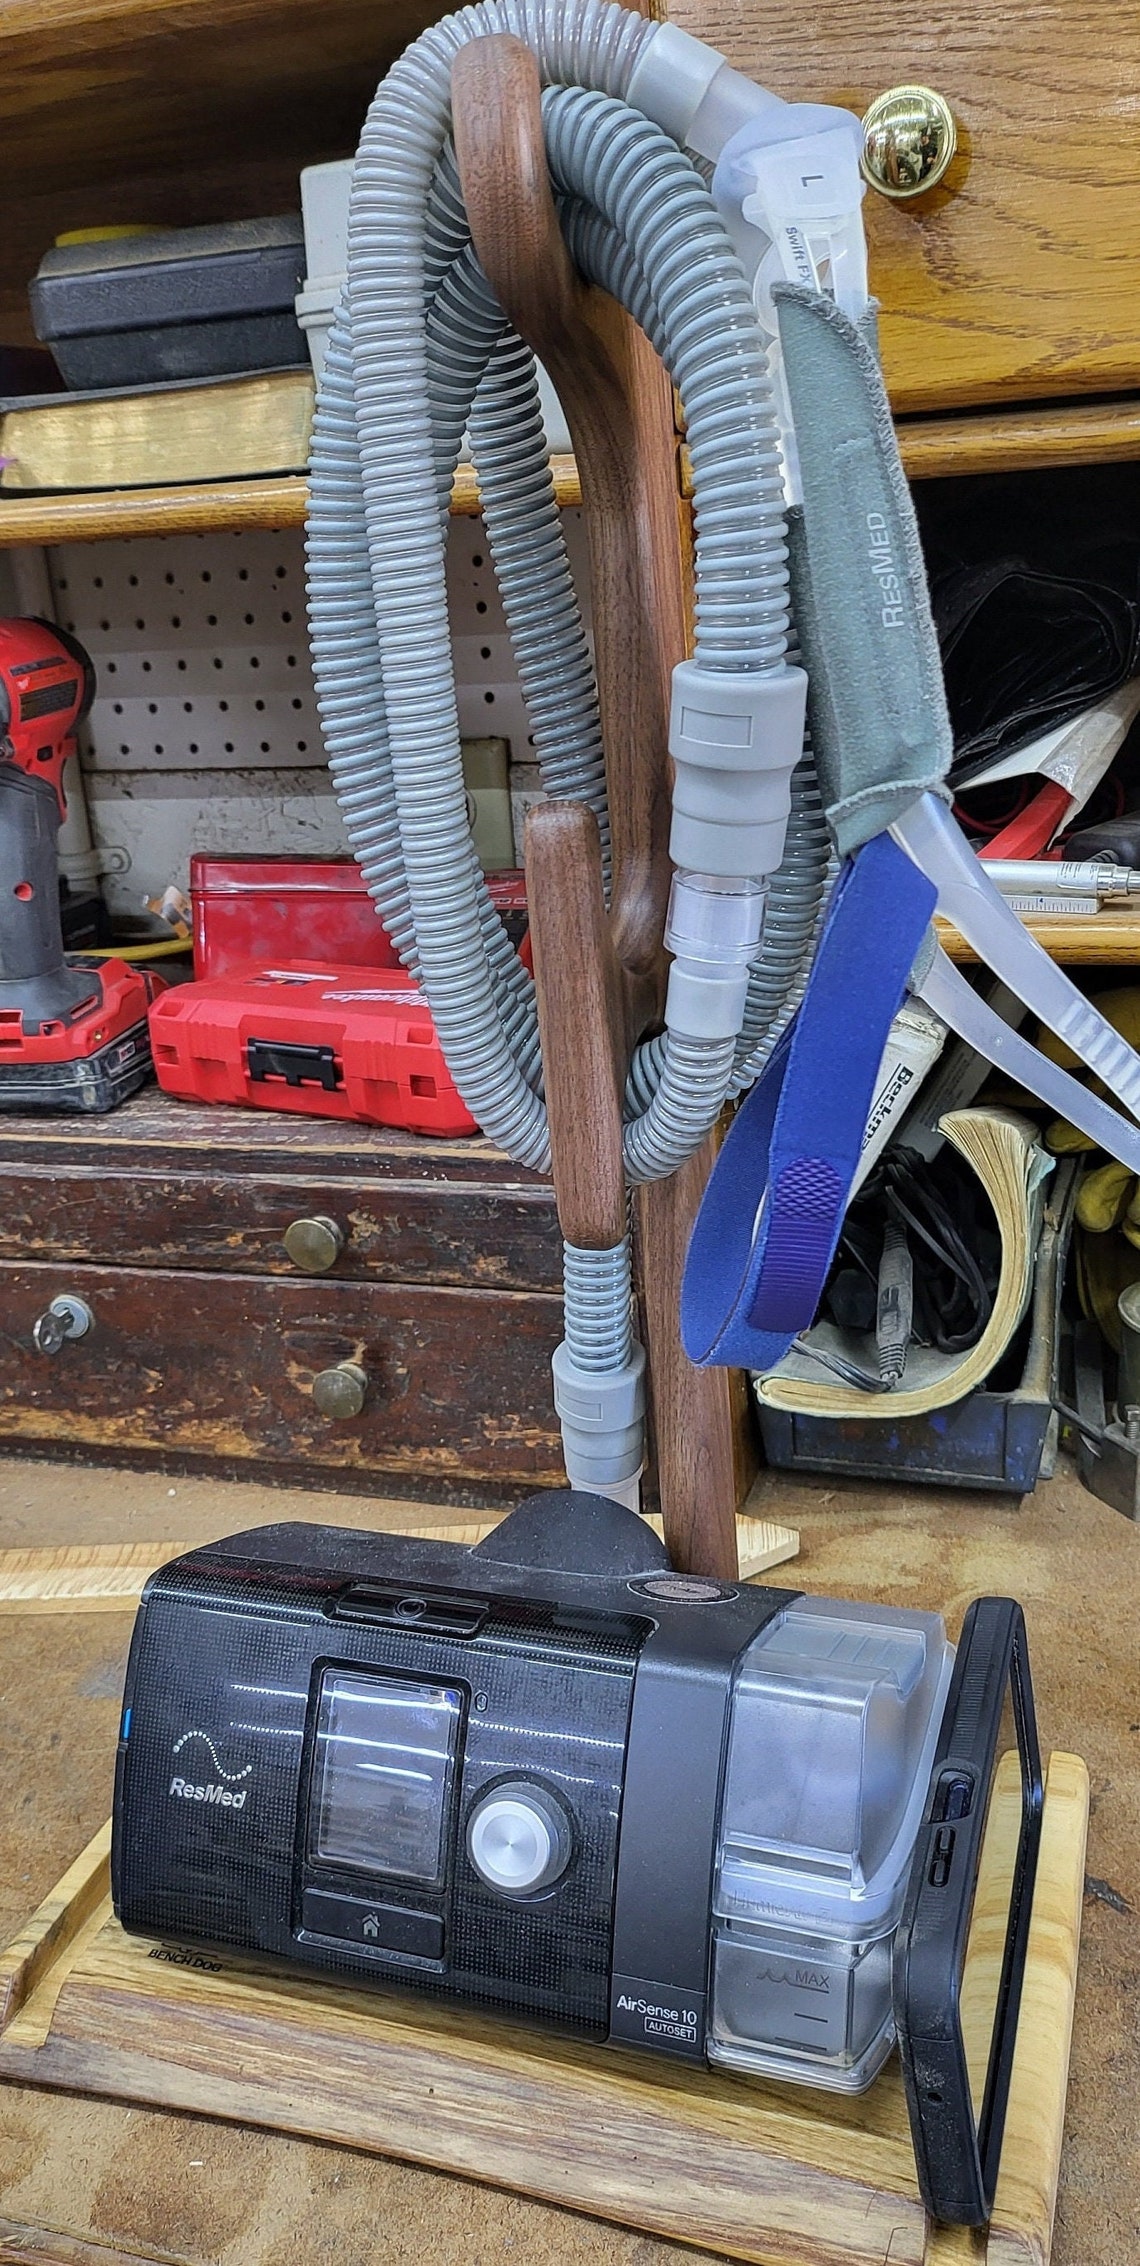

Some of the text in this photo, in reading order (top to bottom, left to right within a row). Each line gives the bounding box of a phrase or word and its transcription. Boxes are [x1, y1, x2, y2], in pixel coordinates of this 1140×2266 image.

[785, 226, 812, 282] Swift FX
[861, 1066, 914, 1152] Beckma
[169, 1777, 247, 1809] ResMed
[147, 1948, 223, 1972] BENCH DOG
[795, 1970, 830, 1988] MAX
[616, 1995, 697, 2025] AirSense 10
[648, 2021, 693, 2039] AUTOSET
